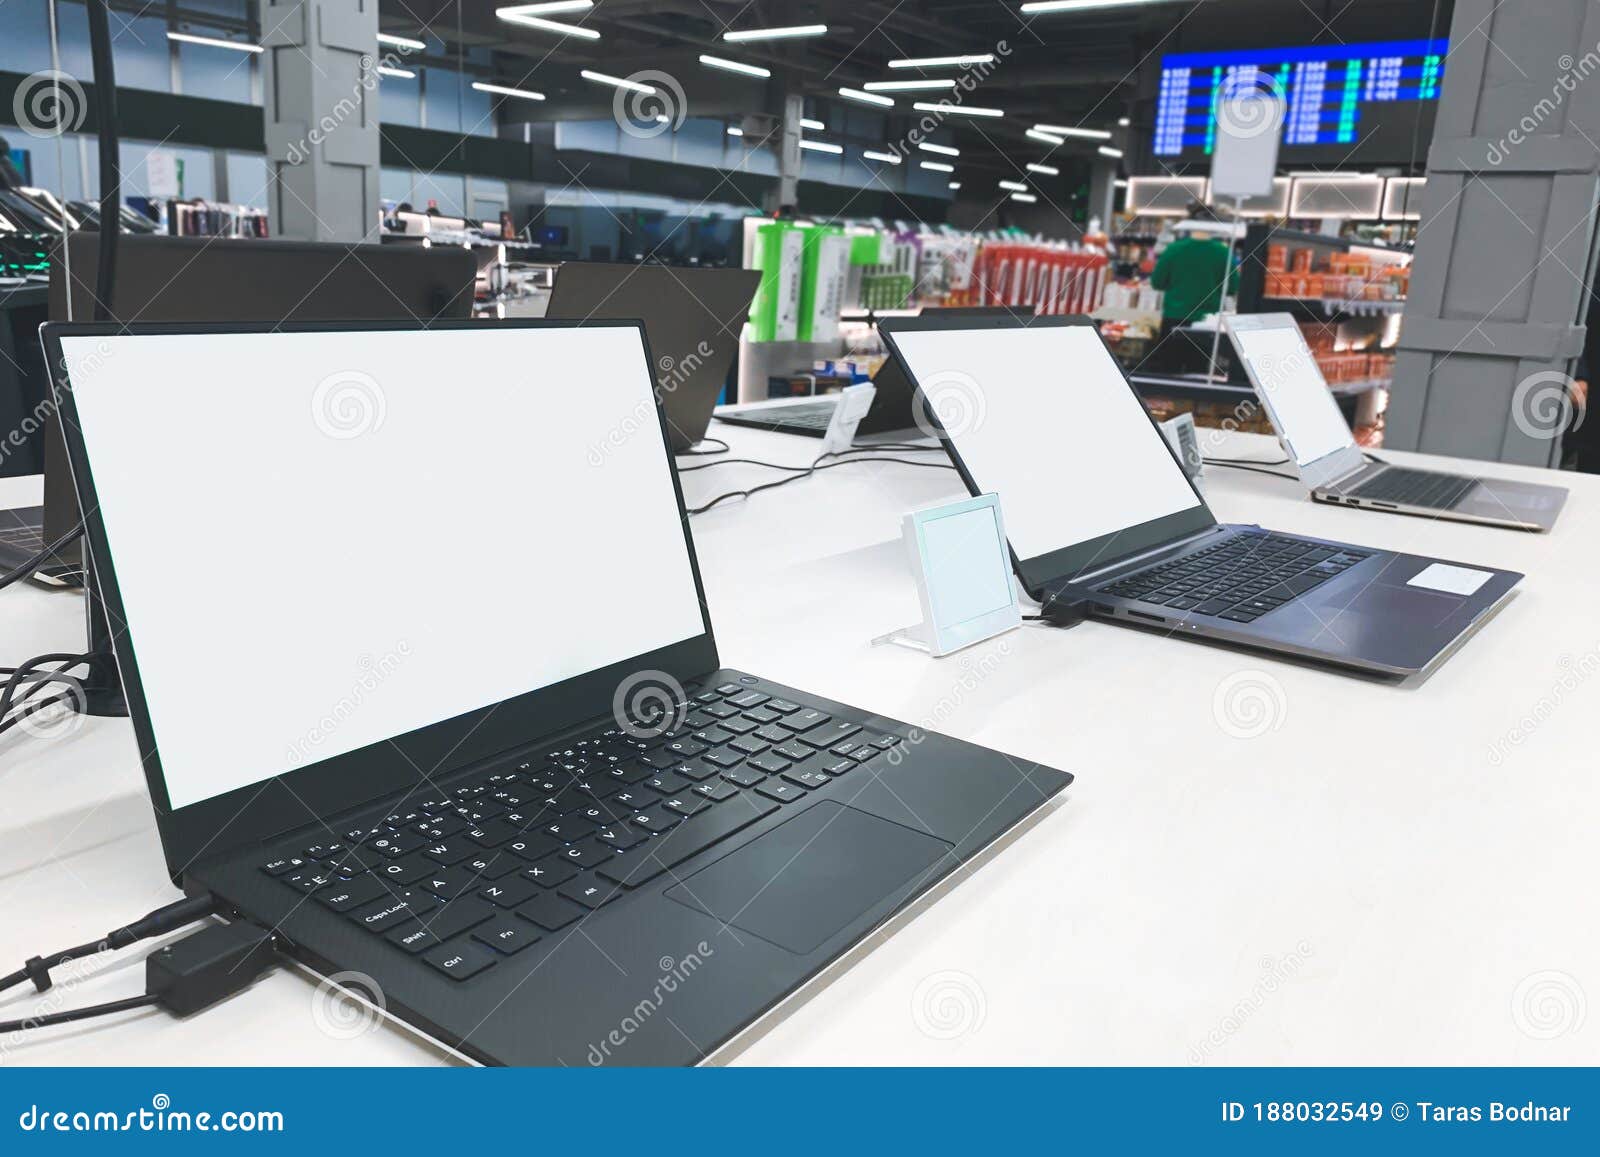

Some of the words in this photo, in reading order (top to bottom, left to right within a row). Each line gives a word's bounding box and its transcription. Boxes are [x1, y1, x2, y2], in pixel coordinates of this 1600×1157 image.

[618, 793, 633, 801] H
[668, 799, 682, 807] N
[636, 815, 650, 823] B
[470, 829, 485, 837] E
[602, 831, 615, 839] V
[429, 844, 448, 854] W
[512, 842, 526, 850] D
[568, 849, 581, 857] C
[473, 860, 486, 869] S
[387, 865, 403, 873] Q
[528, 867, 545, 876] X
[432, 880, 446, 888] A
[486, 887, 503, 896] Z
[330, 894, 349, 903] Tab
[365, 909, 388, 923] Caps
[386, 901, 408, 914] Lock
[402, 931, 427, 945] Shift
[499, 930, 514, 939] Fn
[443, 956, 463, 968] Ctrl
